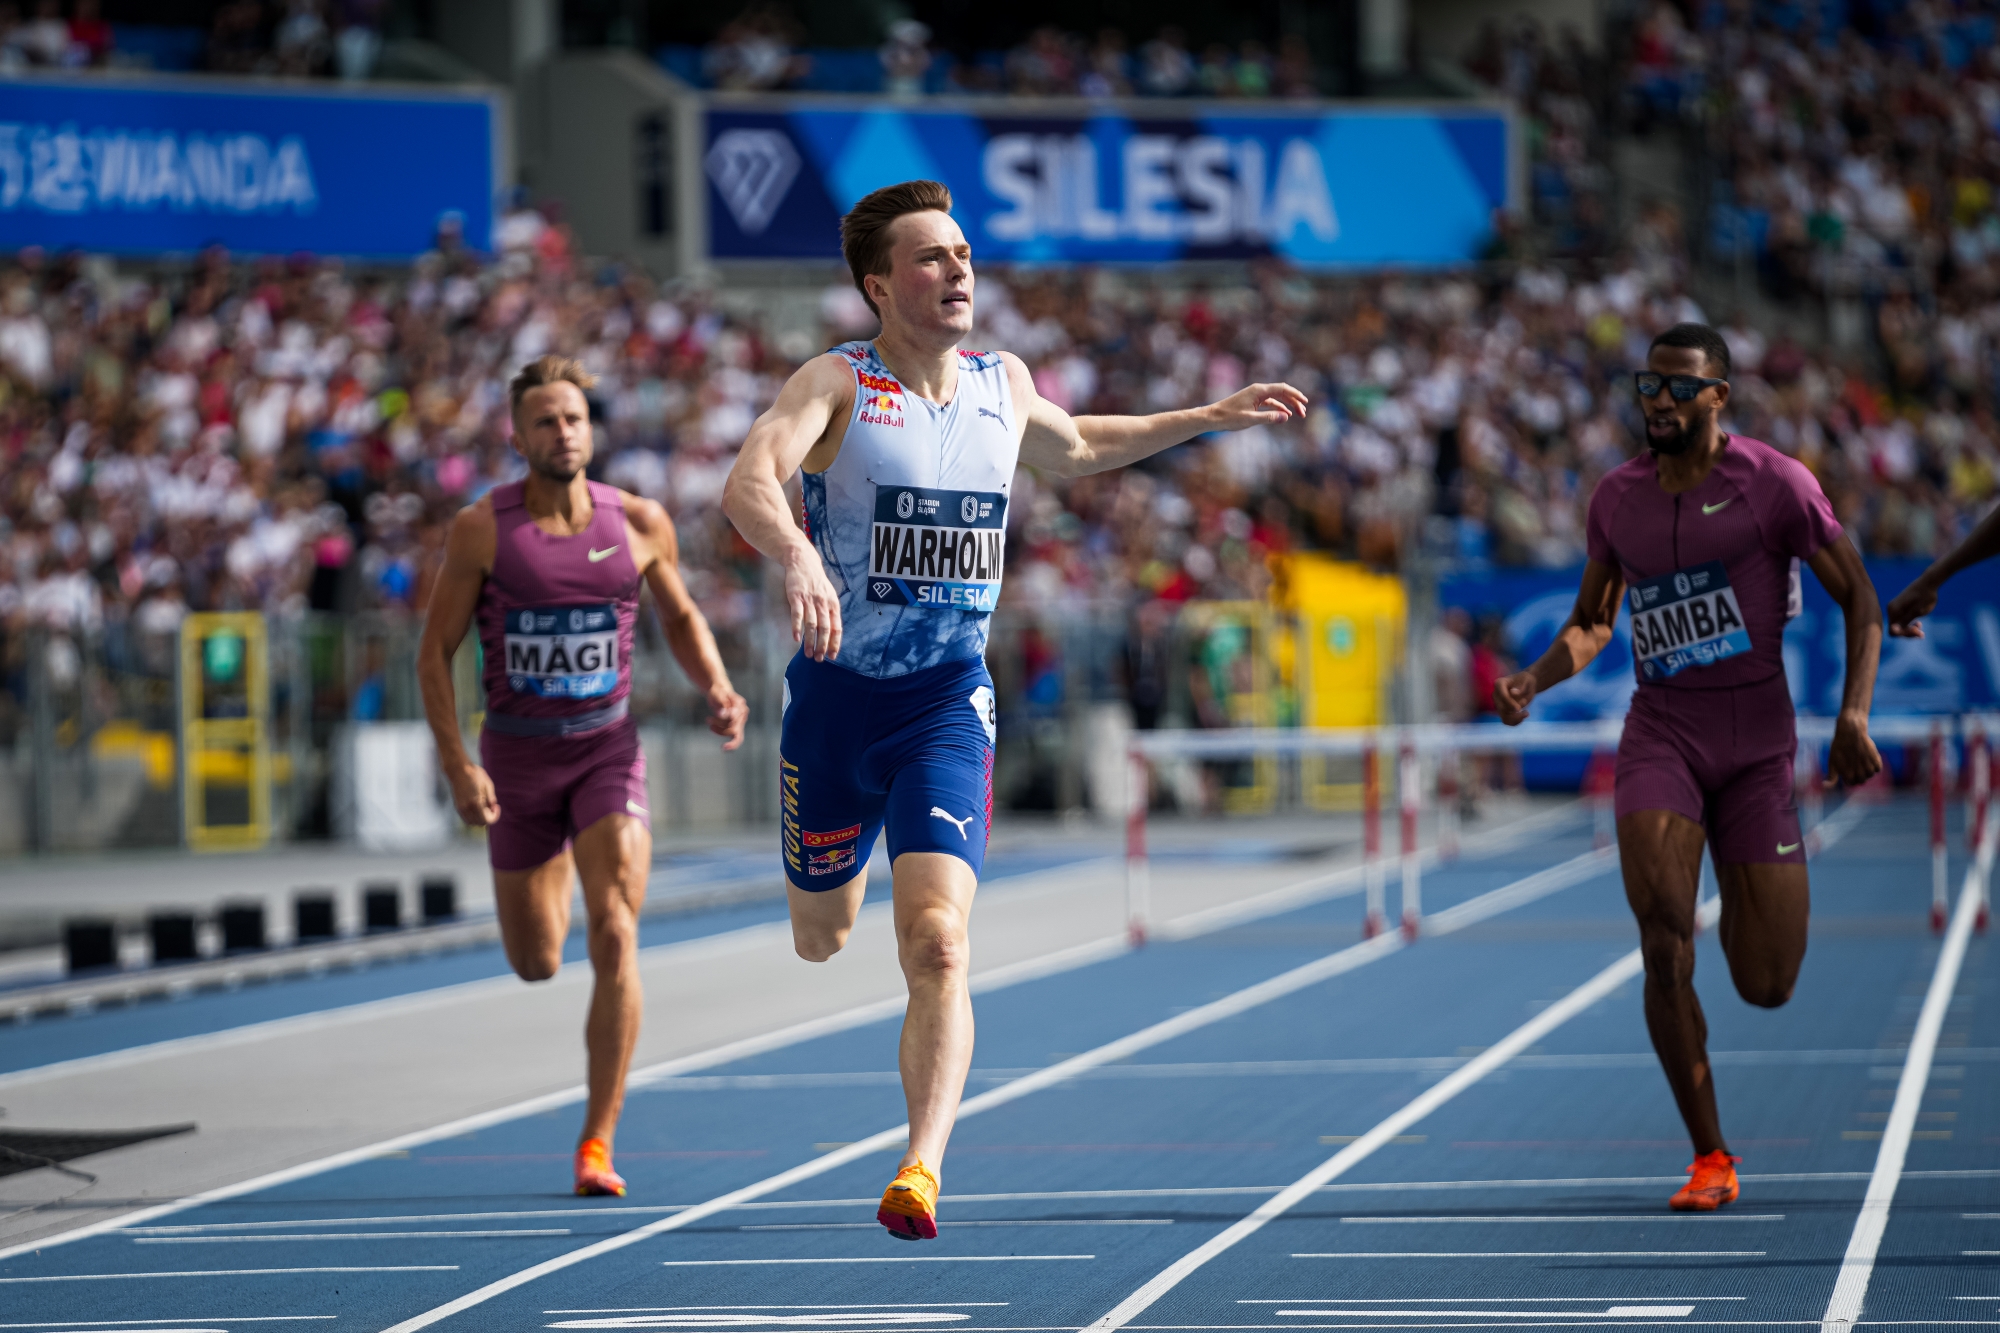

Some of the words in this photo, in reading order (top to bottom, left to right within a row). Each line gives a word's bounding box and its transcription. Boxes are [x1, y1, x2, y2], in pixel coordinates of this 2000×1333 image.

[90, 132, 317, 208] WANDA
[983, 134, 1340, 241] SILESIA
[860, 411, 882, 423] Red
[883, 414, 904, 428] Bull
[874, 525, 1000, 580] WARHOLM
[917, 585, 991, 606] SILESIA
[1633, 592, 1742, 656] SAMBA
[510, 636, 614, 673] MÄGI
[1666, 638, 1734, 669] SILESIA
[781, 757, 802, 872] NORWAY
[824, 829, 855, 842] EXTRA
[808, 863, 834, 875] Red
[834, 853, 856, 872] Bull
